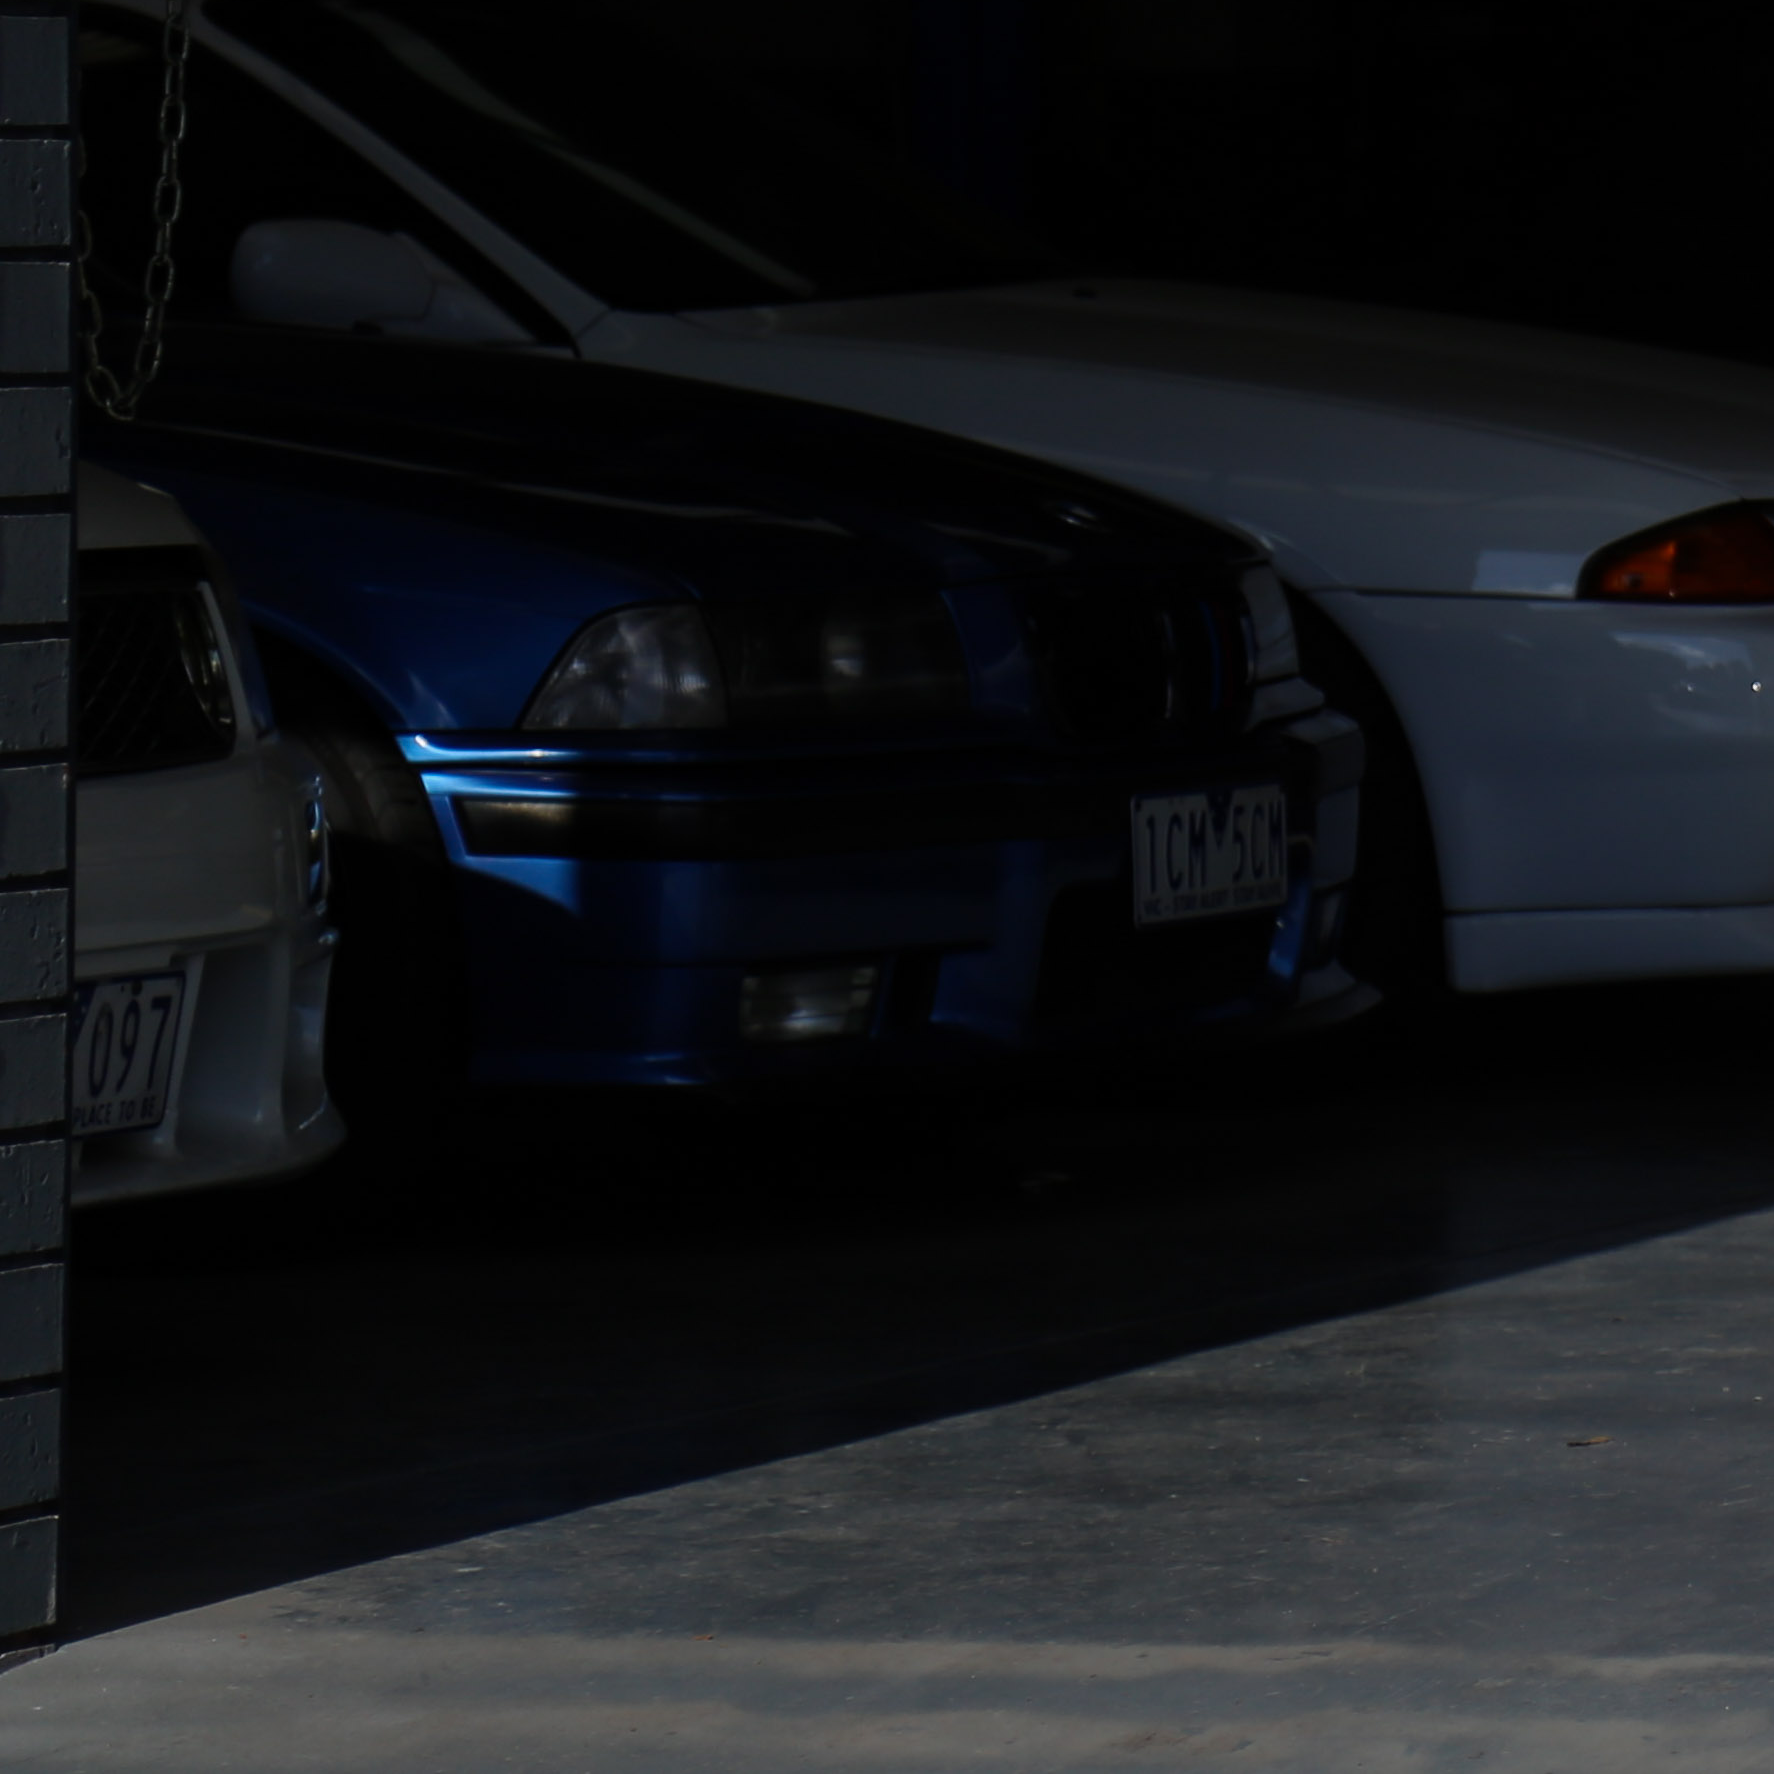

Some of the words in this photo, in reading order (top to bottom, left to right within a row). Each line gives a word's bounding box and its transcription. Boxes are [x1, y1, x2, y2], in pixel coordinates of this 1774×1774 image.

[1146, 811, 1206, 894] 1CM
[90, 996, 171, 1096] 097
[119, 1098, 136, 1122] TO
[140, 1096, 157, 1120] BE
